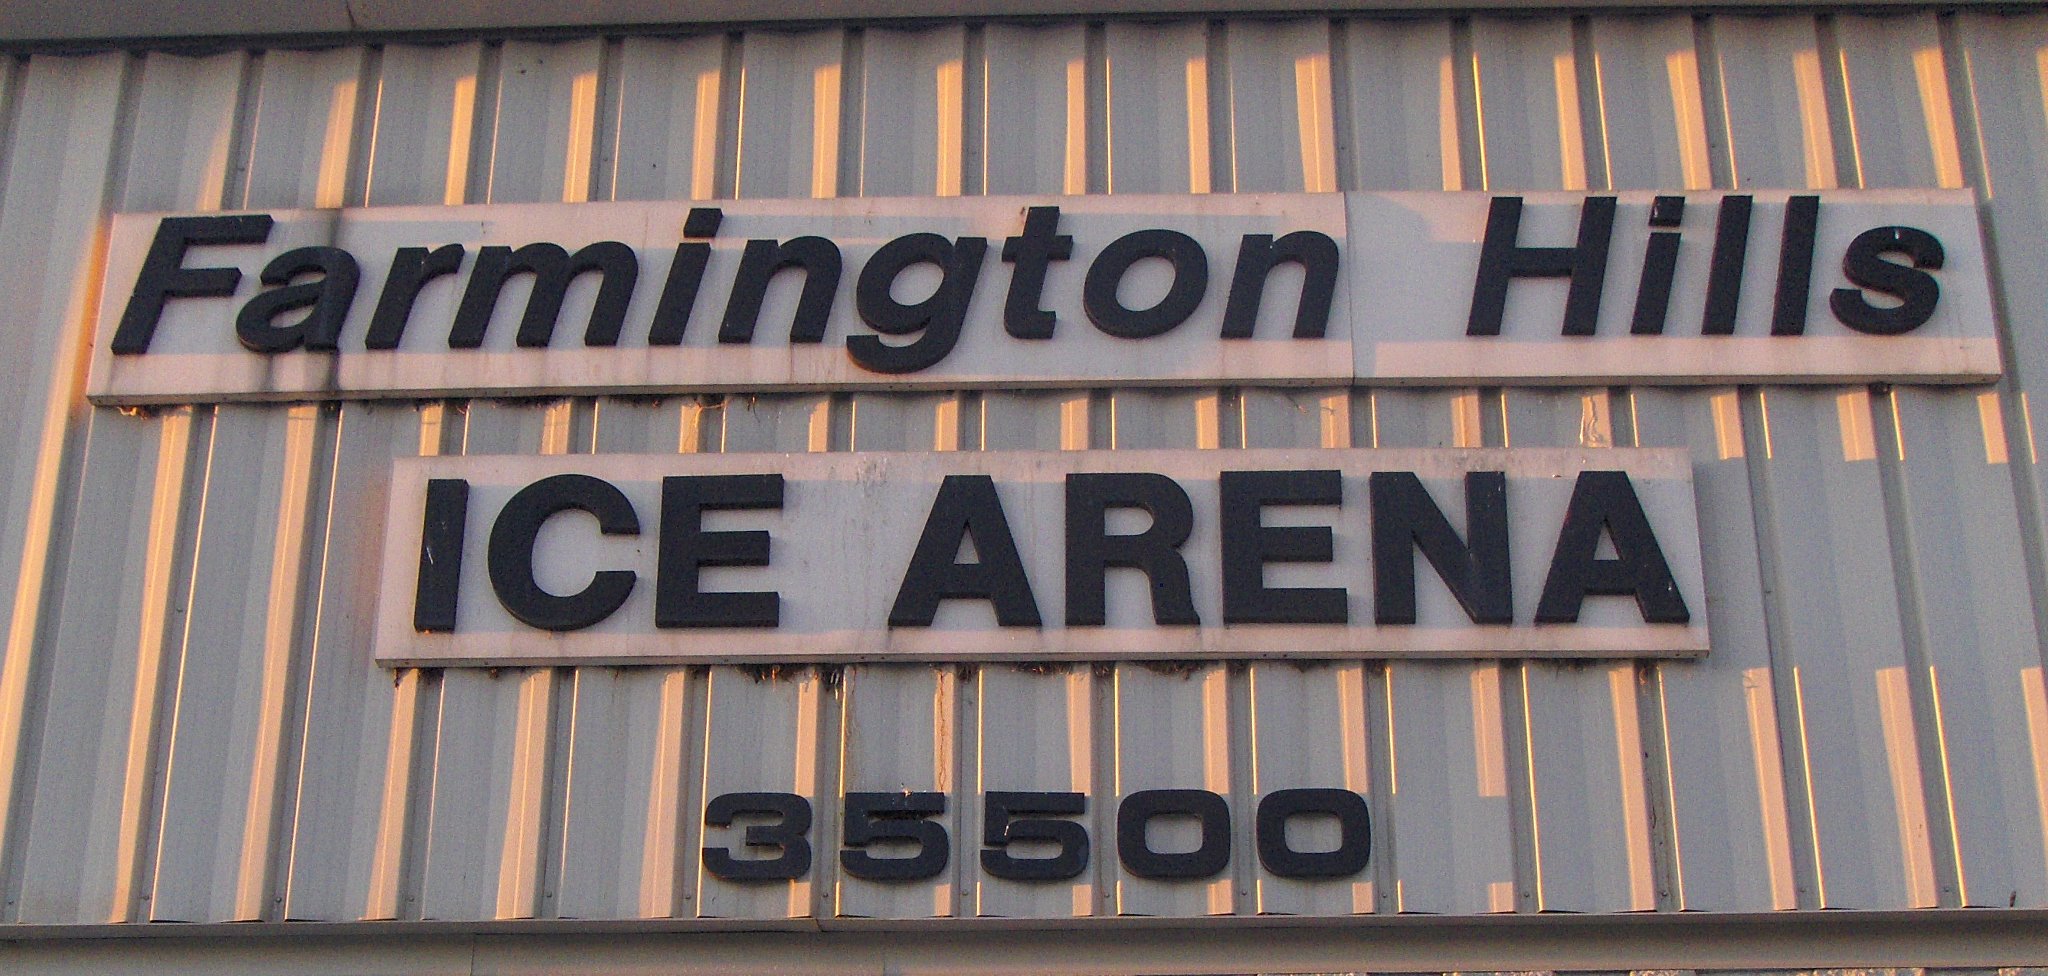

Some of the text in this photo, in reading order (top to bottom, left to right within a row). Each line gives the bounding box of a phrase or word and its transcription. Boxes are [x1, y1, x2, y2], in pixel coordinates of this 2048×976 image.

[111, 195, 1945, 375] Farmington Hills
[413, 469, 1691, 634] ICE ARENA
[702, 788, 1372, 889] 35500
